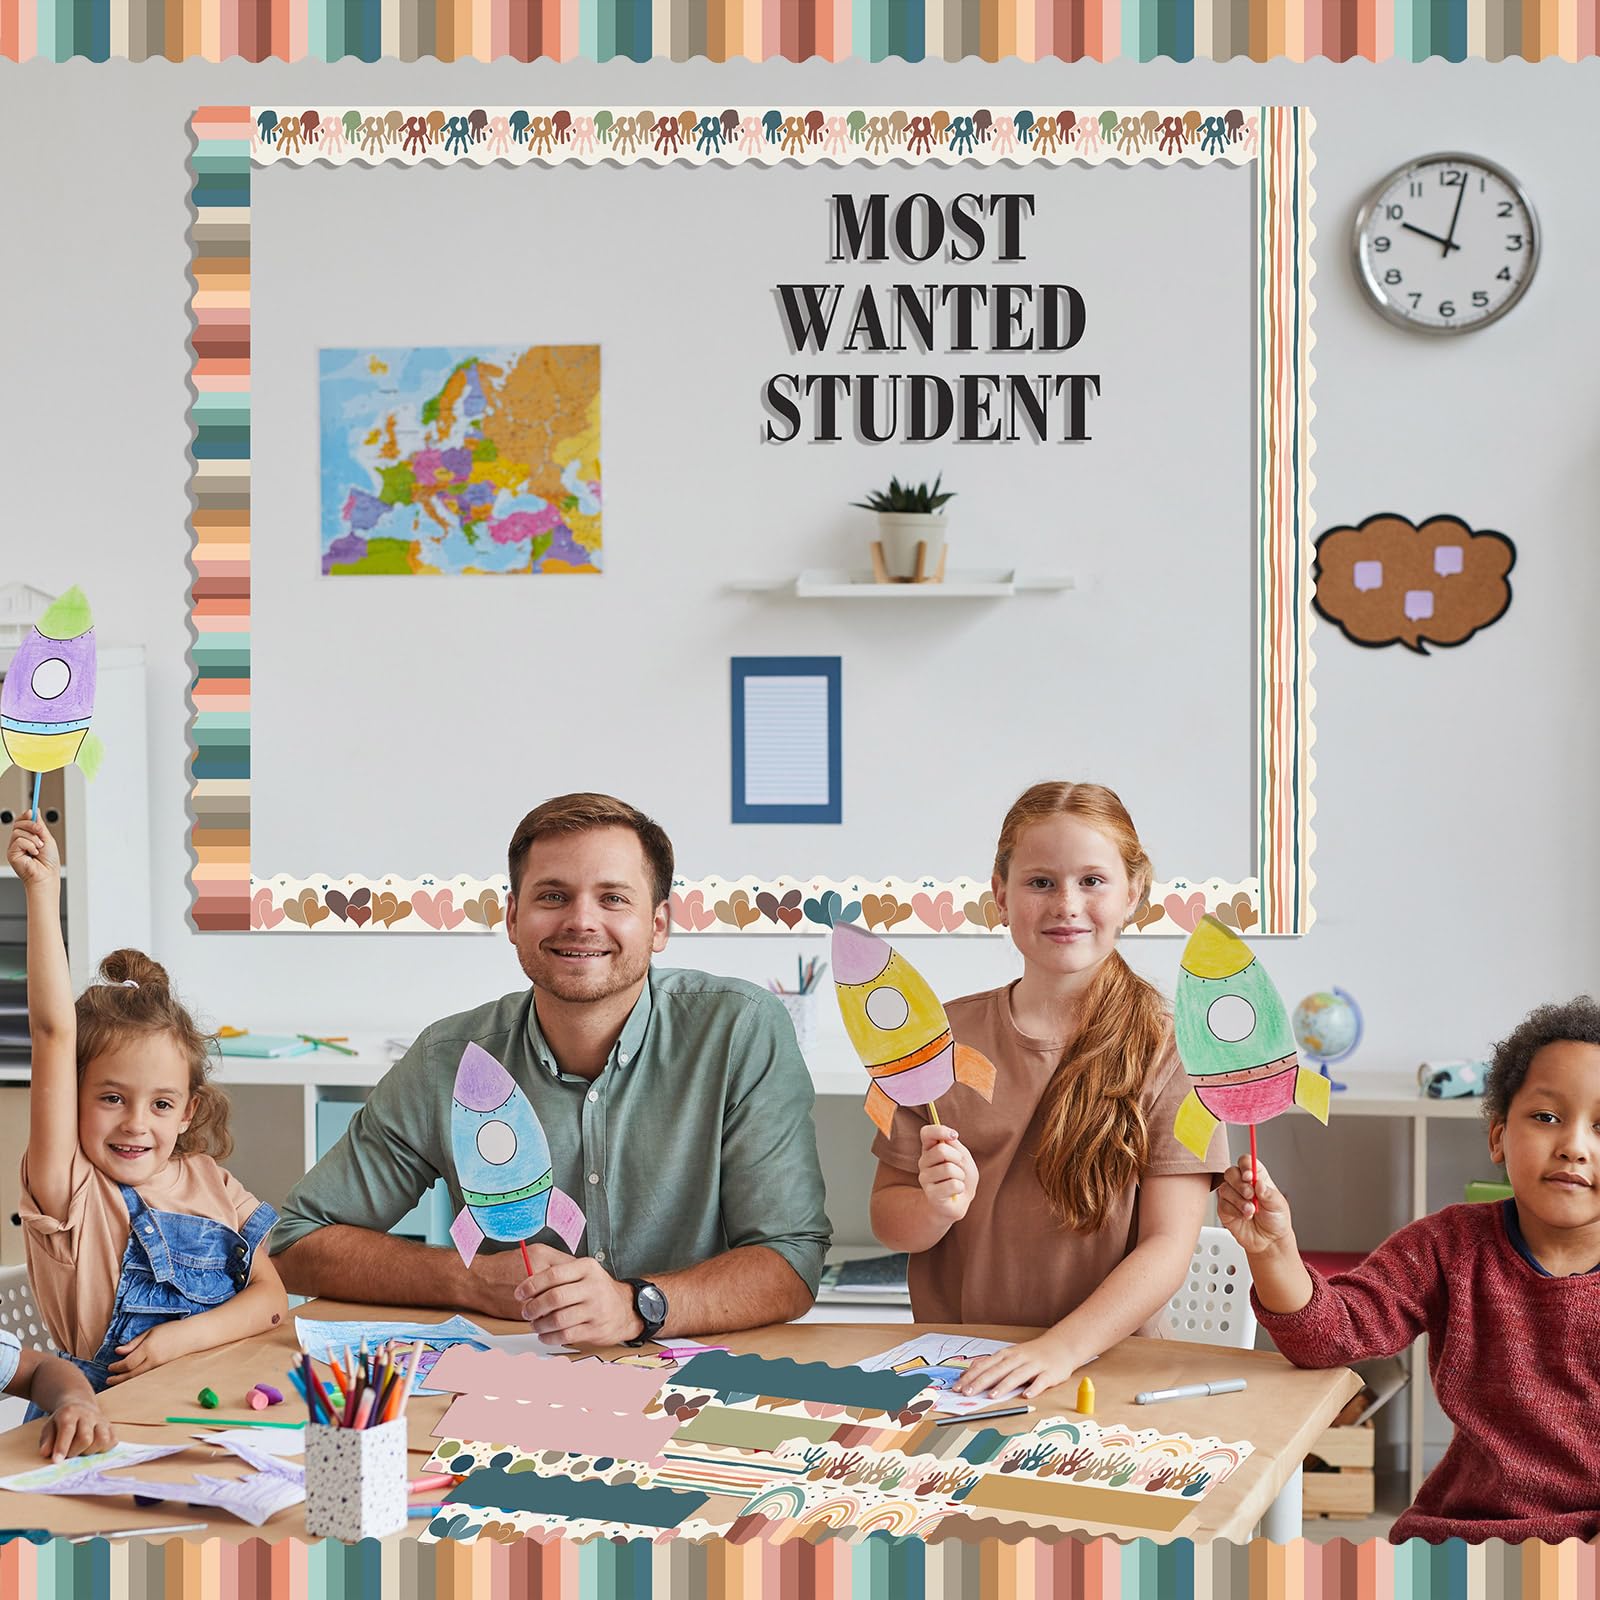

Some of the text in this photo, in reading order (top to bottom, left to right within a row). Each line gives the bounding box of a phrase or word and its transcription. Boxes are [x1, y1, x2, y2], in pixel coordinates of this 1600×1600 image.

[1439, 170, 1461, 186] 12
[1479, 177, 1486, 193] 1
[1409, 182, 1423, 198] 11
[1385, 204, 1404, 221] 10
[1496, 201, 1513, 218] 2
[831, 193, 1036, 262] MOST
[1374, 236, 1391, 253] 9
[1505, 234, 1523, 251] 3
[1384, 269, 1402, 285] 8
[1496, 266, 1511, 282] 4
[1407, 292, 1422, 309] 7
[1471, 291, 1490, 308] 5
[1438, 301, 1456, 317] 6
[776, 284, 1087, 352] WANTED
[767, 373, 1101, 442] STUDENT
